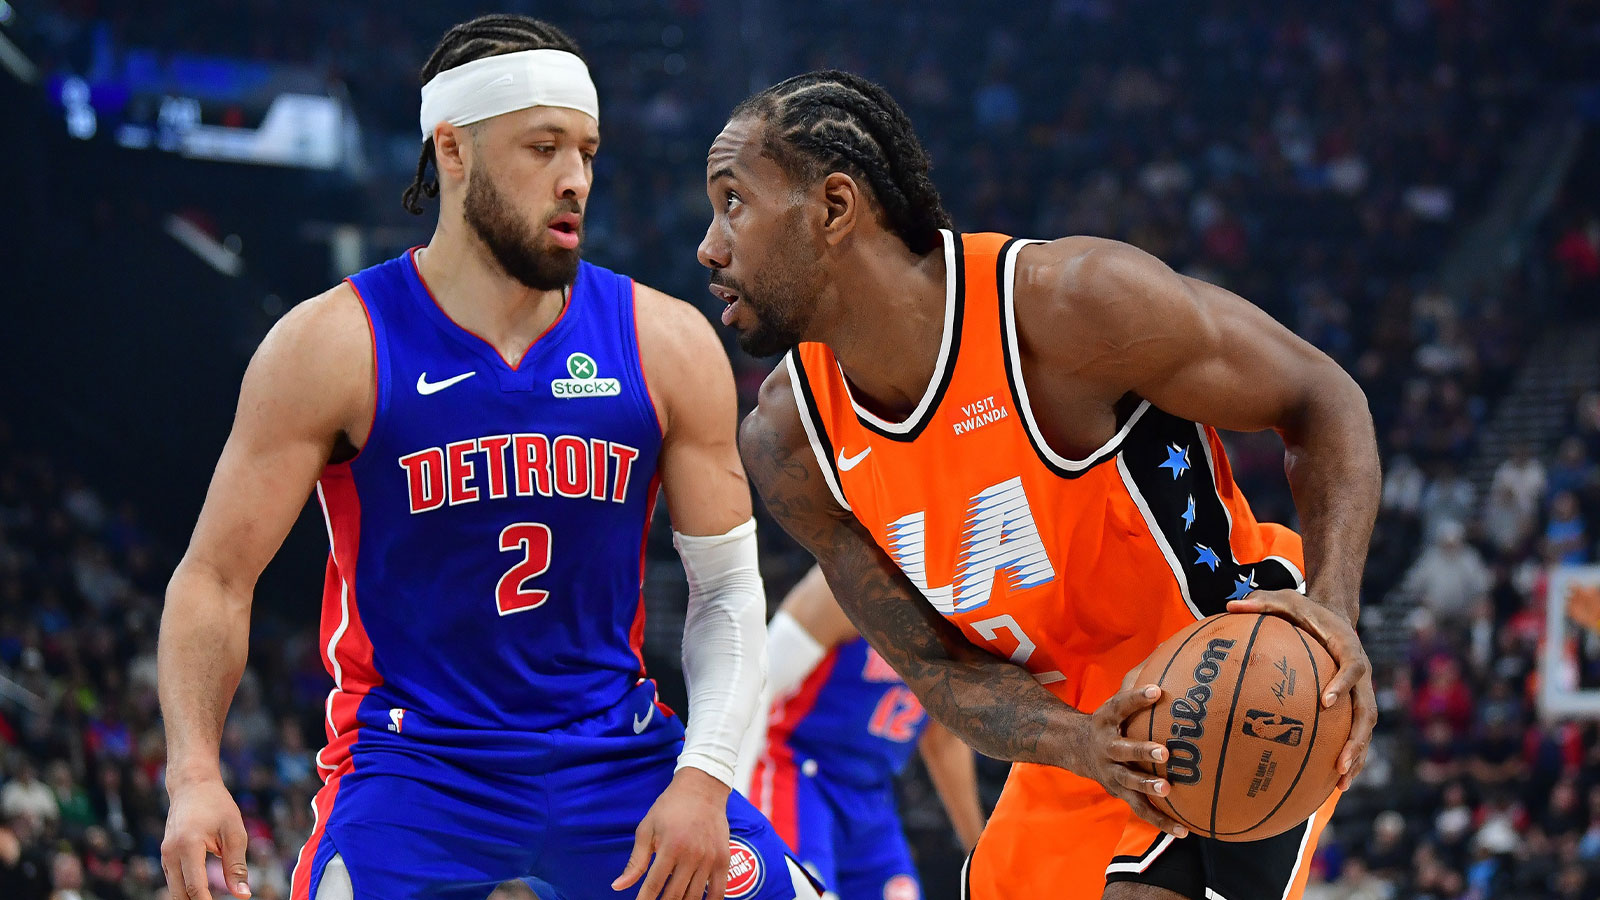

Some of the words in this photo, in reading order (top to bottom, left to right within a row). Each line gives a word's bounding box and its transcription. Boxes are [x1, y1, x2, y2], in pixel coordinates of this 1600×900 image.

[554, 381, 617, 395] StockX
[961, 396, 995, 417] VISIT
[952, 405, 1009, 435] RWANDA
[398, 433, 640, 514] DETROIT
[495, 522, 553, 617] 2
[886, 475, 1056, 616] LA
[868, 685, 928, 743] 12
[1165, 637, 1237, 786] Wilson
[727, 860, 752, 882] TONS
